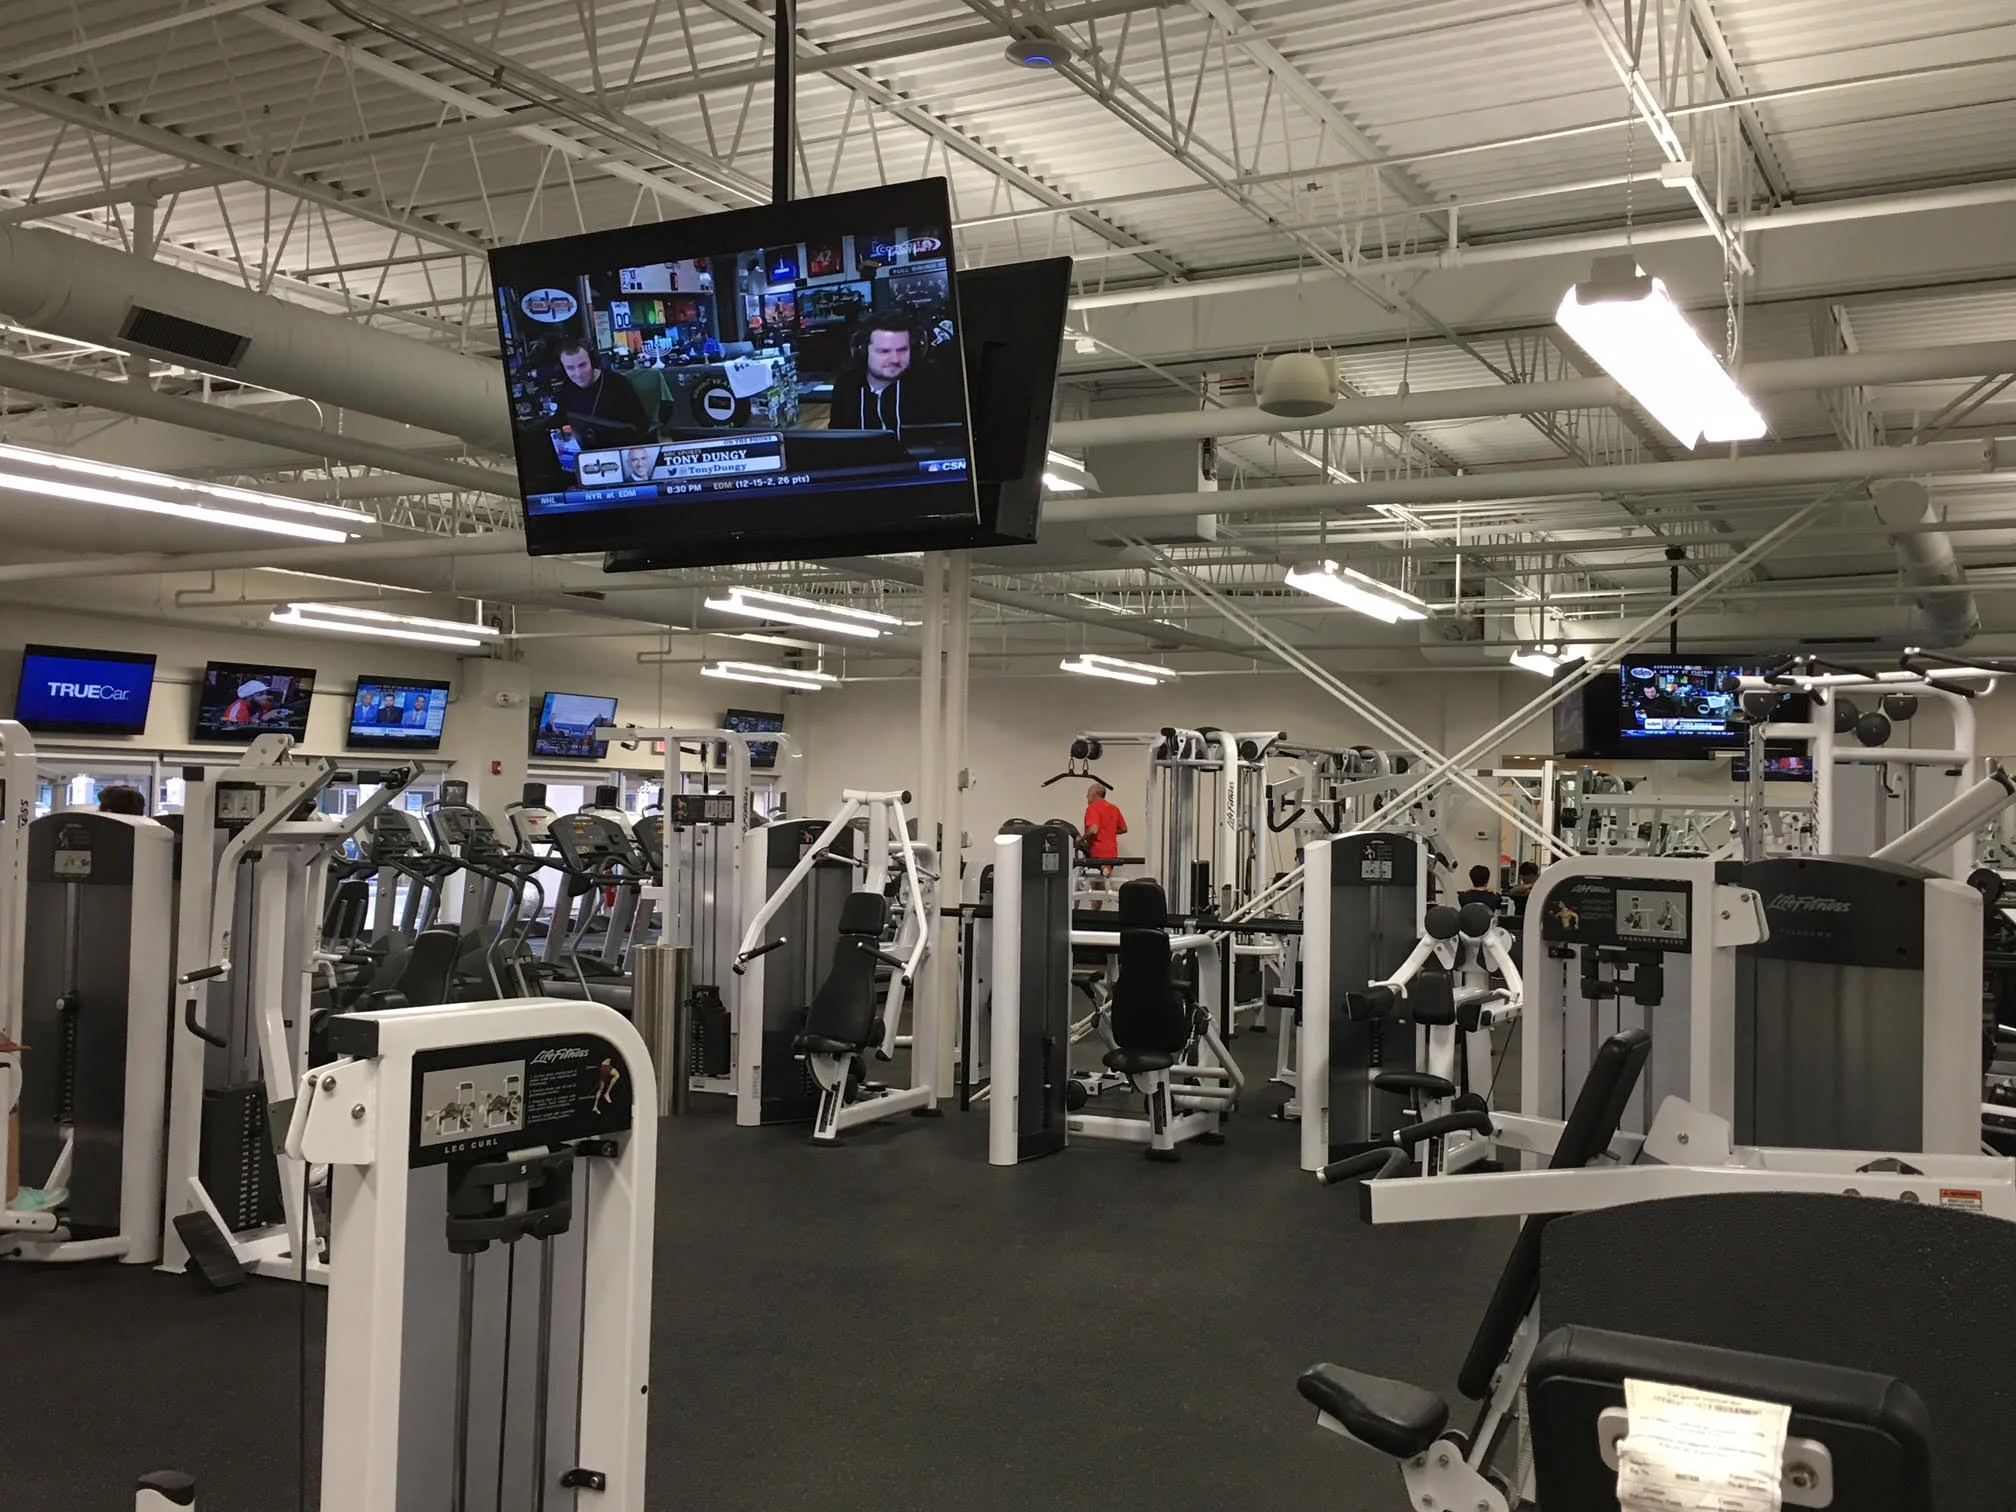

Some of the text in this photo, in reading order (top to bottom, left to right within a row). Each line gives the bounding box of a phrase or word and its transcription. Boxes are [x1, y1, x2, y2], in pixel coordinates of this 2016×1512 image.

[663, 449, 747, 466] TONY DUNGY
[942, 461, 967, 471] CSN
[777, 476, 790, 485] 26
[792, 475, 810, 486] pts)
[666, 483, 702, 494] 8:30 PM
[585, 493, 602, 501] NYR
[619, 490, 637, 498] EDM
[444, 1138, 499, 1154] LEG CURL
[520, 1165, 528, 1175] 5
